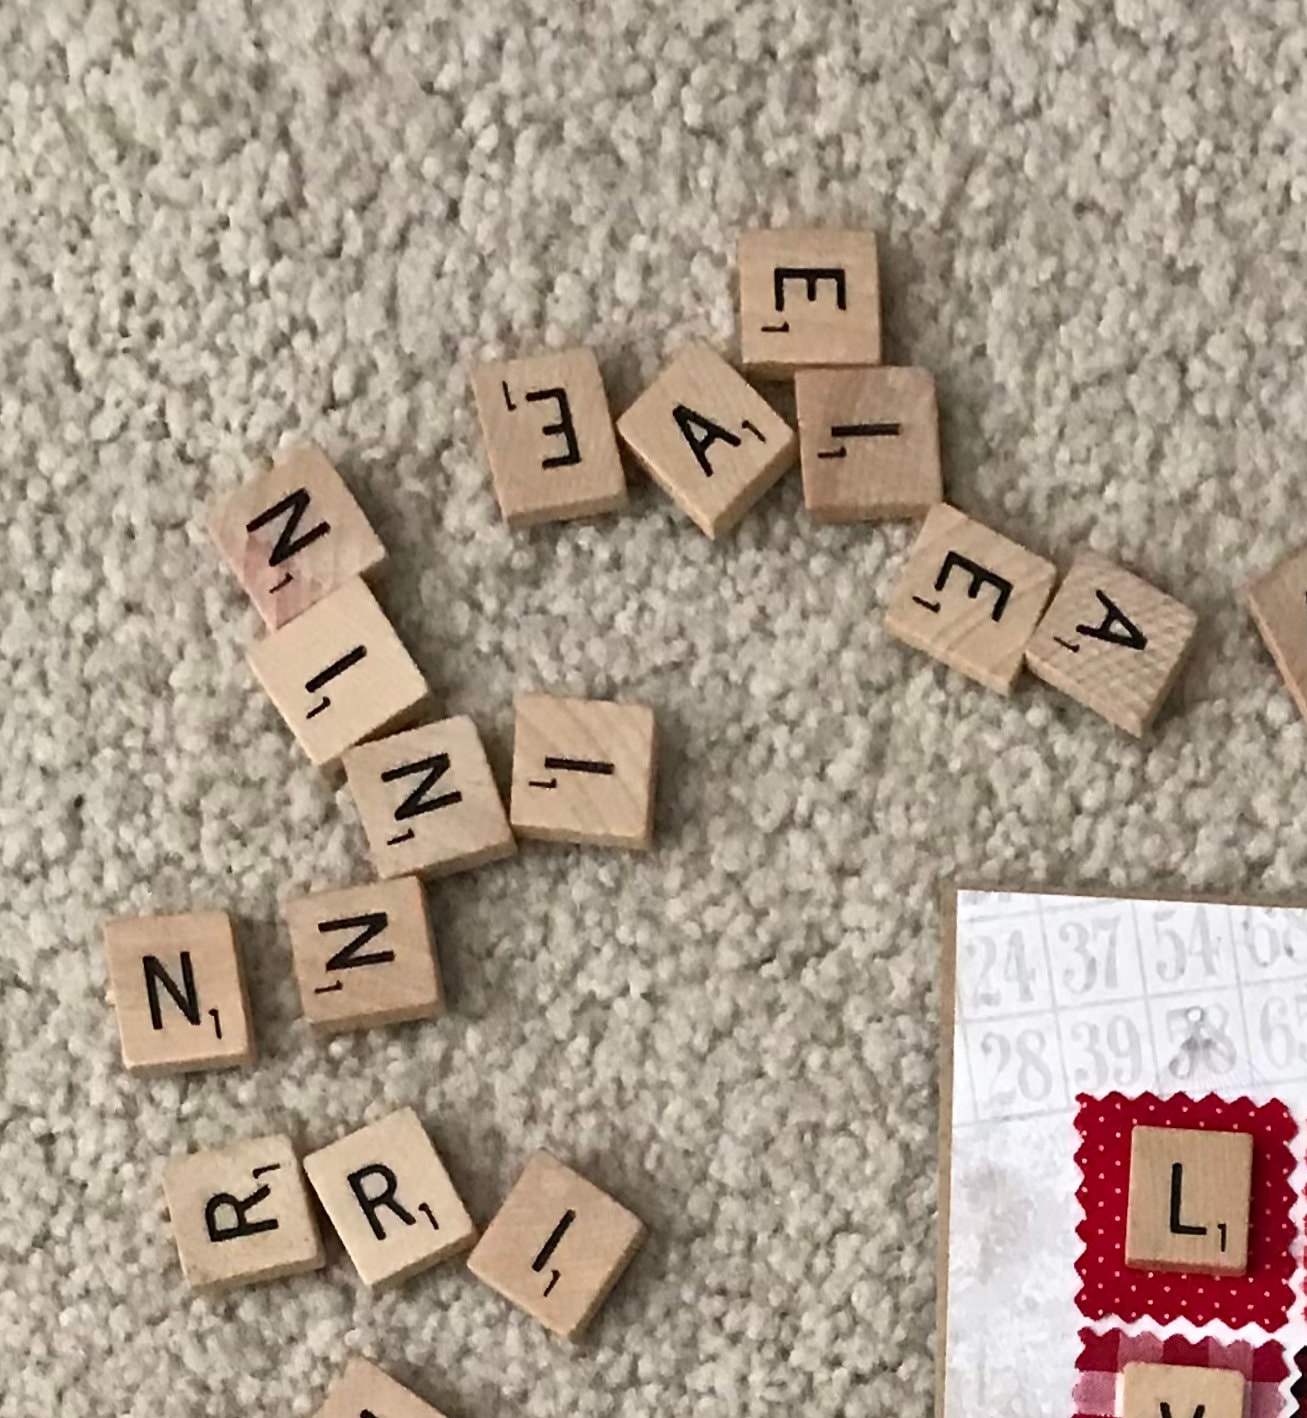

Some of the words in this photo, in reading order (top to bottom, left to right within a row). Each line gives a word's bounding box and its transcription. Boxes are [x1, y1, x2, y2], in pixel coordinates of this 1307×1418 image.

[963, 929, 1037, 1008] 24
[1058, 914, 1122, 995] 37
[1152, 905, 1221, 983] 54
[979, 1027, 1053, 1111] 28
[1070, 1013, 1144, 1092] 39
